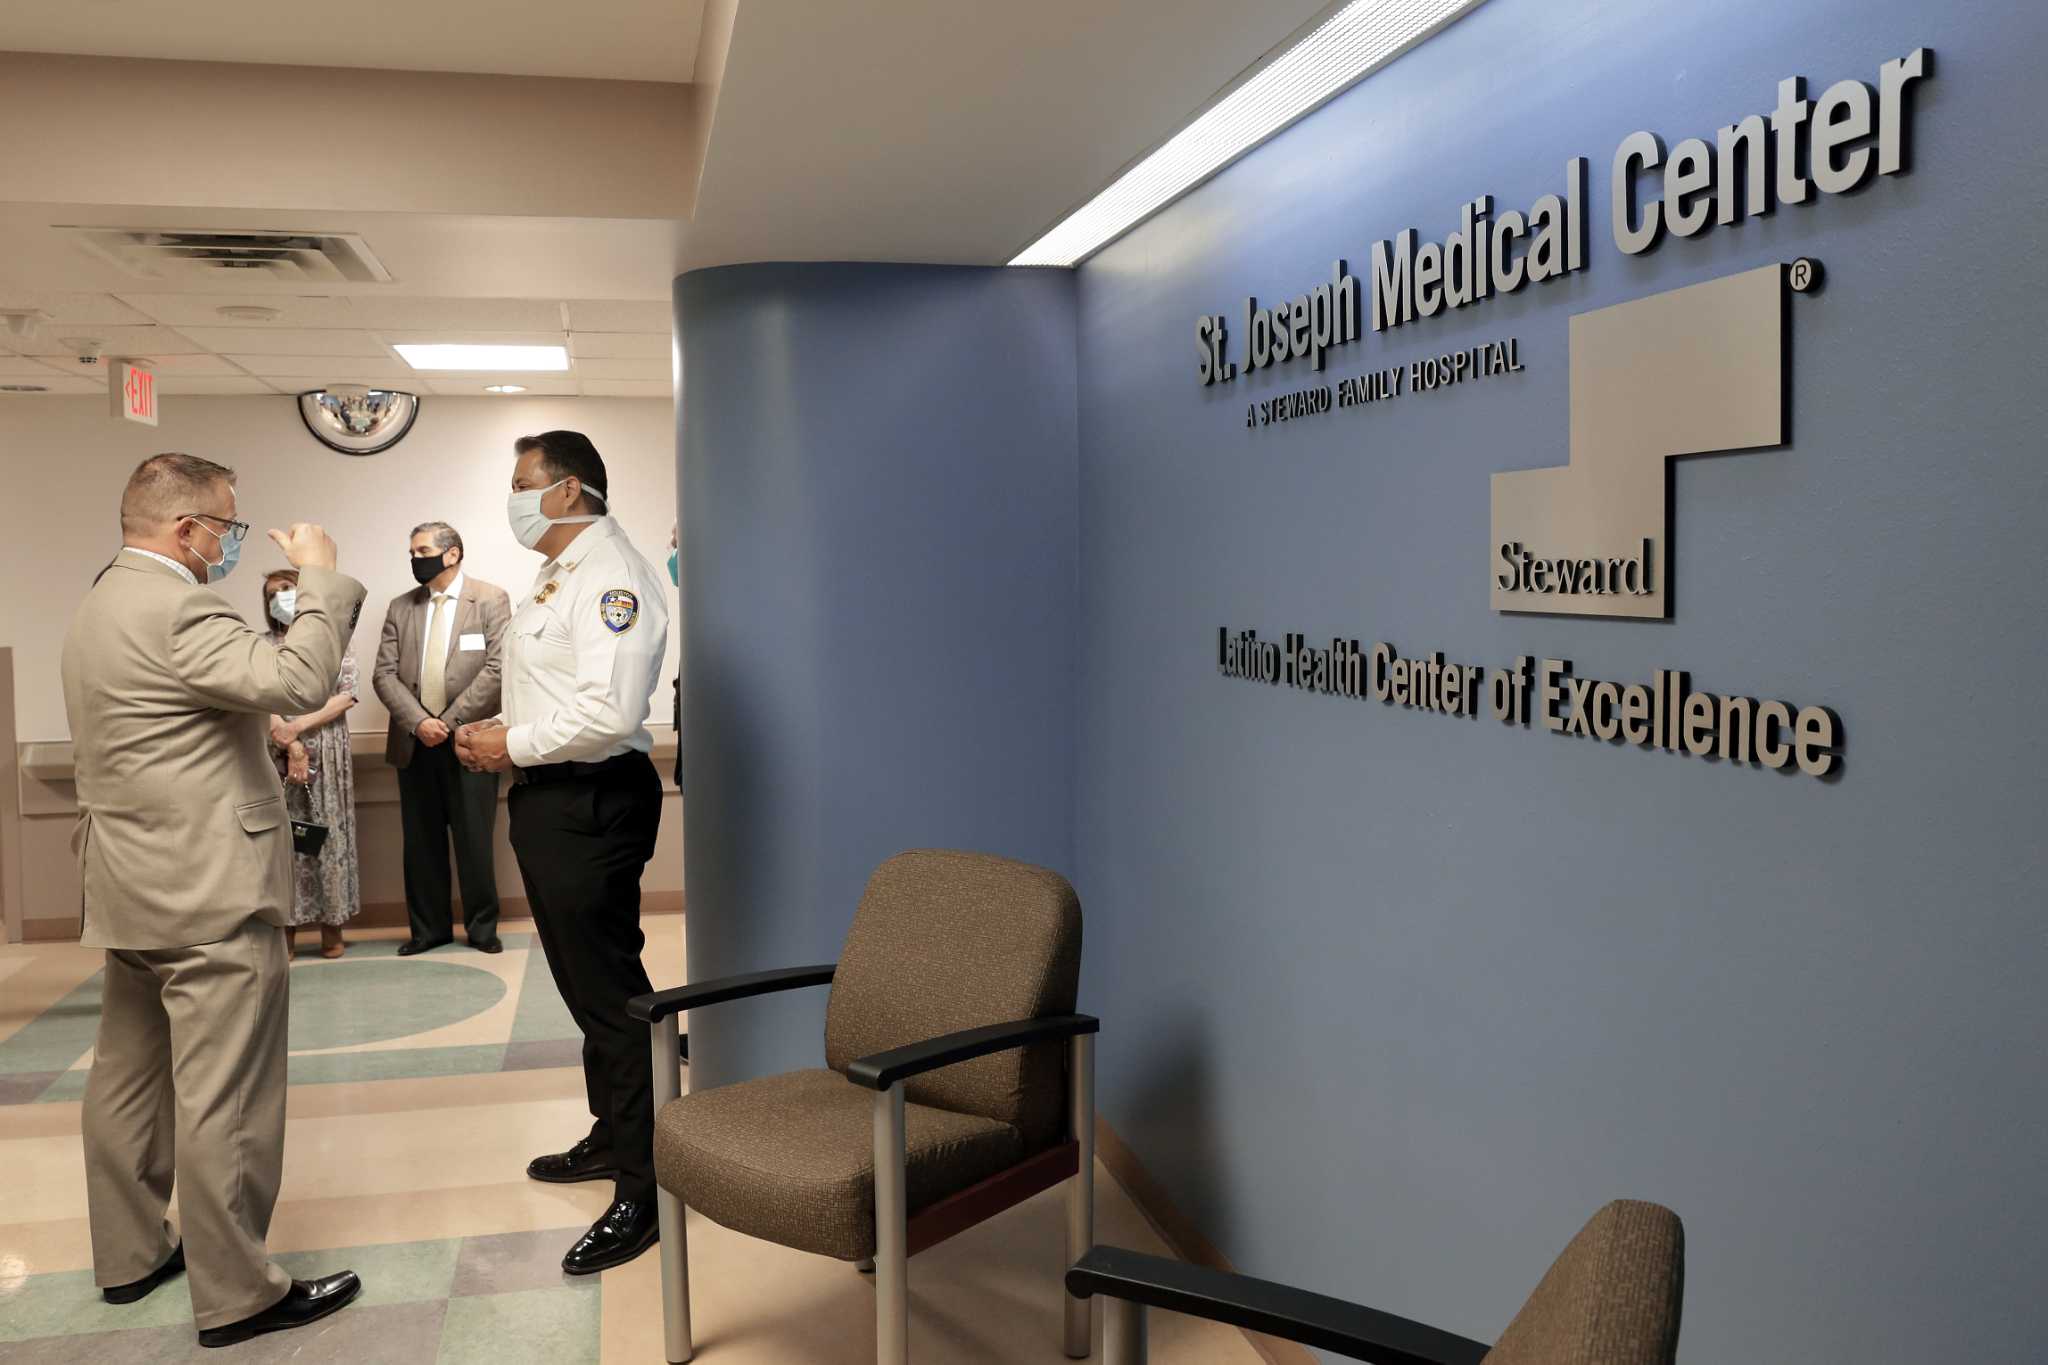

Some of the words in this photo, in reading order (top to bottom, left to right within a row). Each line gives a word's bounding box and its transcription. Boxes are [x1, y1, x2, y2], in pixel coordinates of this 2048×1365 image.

[1197, 315, 1235, 385] St.
[1242, 260, 1358, 373] Joseph
[1372, 157, 1585, 331] Medical
[1612, 48, 1929, 255] Center
[130, 367, 153, 417] EXIT
[1247, 403, 1256, 427] A
[1261, 385, 1330, 425] STEWARD
[1339, 367, 1402, 407] FAMILY
[1410, 338, 1523, 391] HOSPITAL
[1498, 538, 1654, 595] Steward
[1217, 627, 1278, 681] Latino
[1281, 633, 1365, 697] Health
[1371, 642, 1481, 717] Center
[1490, 656, 1533, 724] of
[1542, 659, 1842, 777] Excellence
